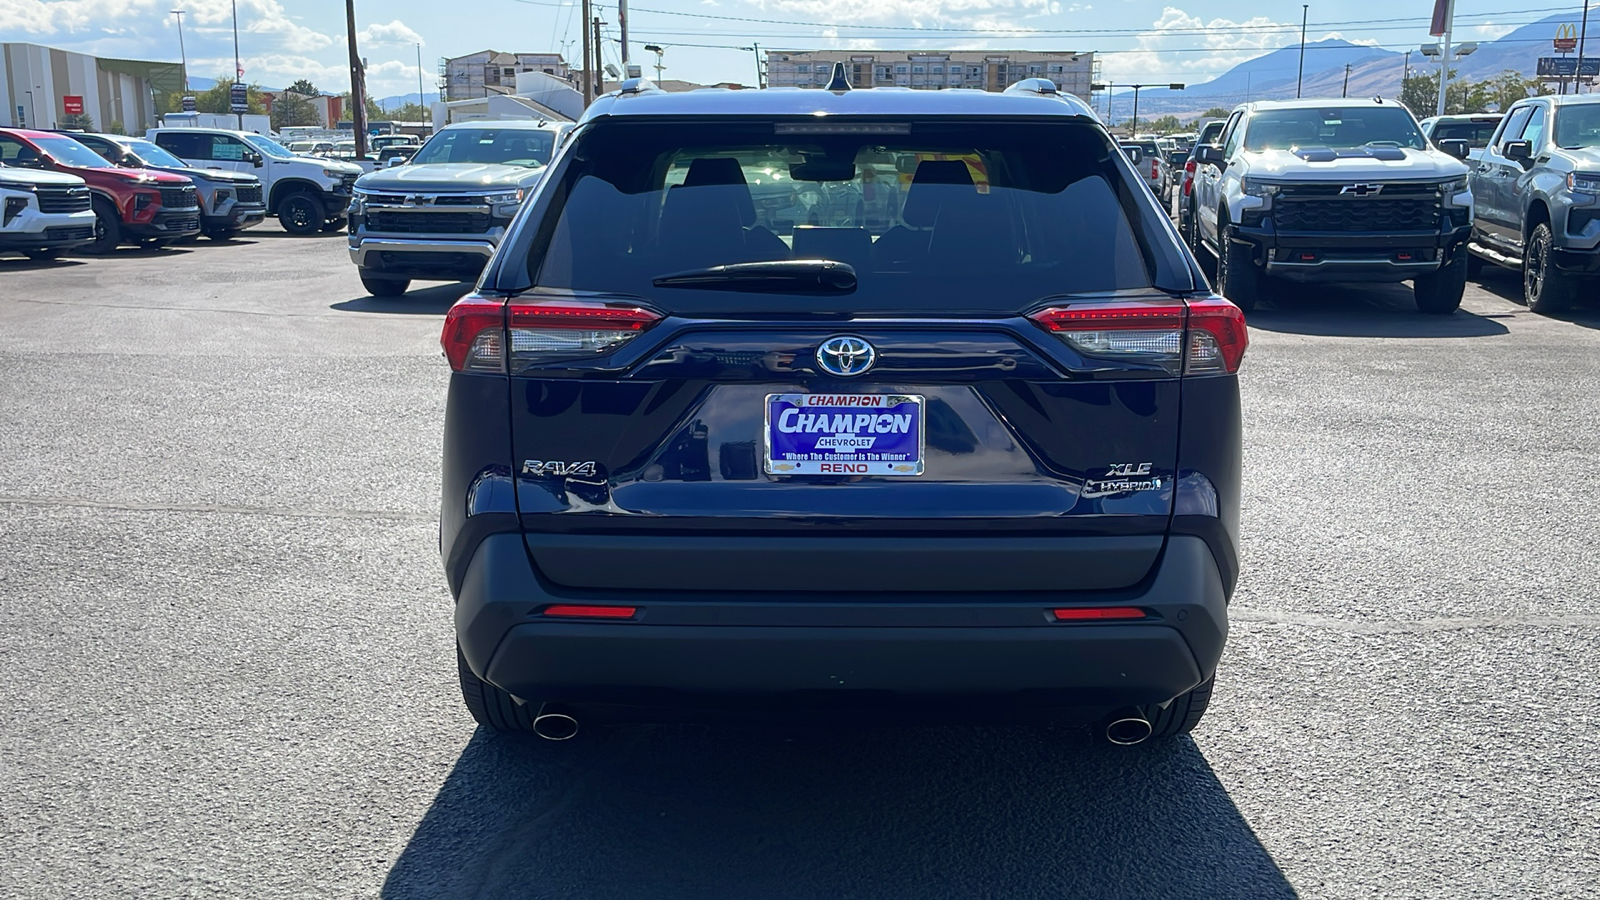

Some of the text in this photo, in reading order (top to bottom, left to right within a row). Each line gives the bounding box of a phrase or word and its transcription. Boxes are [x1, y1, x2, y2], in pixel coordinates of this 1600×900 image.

[808, 395, 882, 406] CHAMPION
[778, 408, 912, 433] CHAMPION
[819, 438, 871, 446] CHEVROLET
[810, 452, 823, 461] The
[824, 452, 857, 461] Customer
[859, 452, 866, 461] Is
[867, 452, 880, 461] The
[522, 460, 597, 477] RAV4
[820, 463, 868, 473] RENO
[1105, 462, 1153, 476] XLE
[1101, 481, 1153, 491] HYBRID
